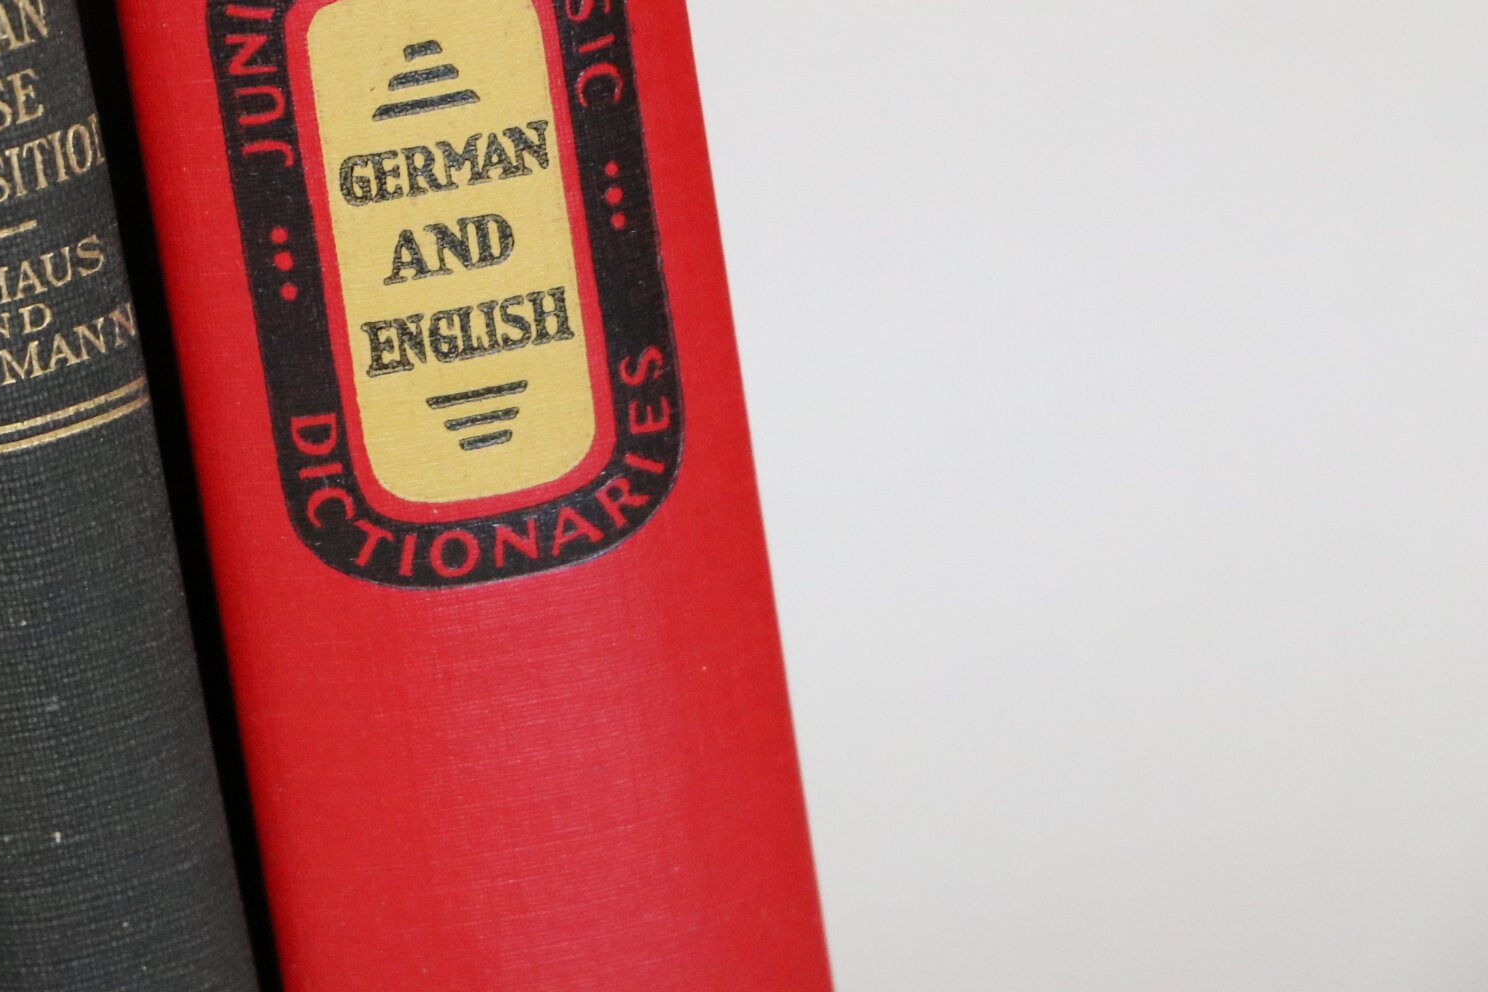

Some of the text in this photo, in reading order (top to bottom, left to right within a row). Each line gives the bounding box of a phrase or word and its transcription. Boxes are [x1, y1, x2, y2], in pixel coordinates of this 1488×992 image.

[339, 119, 550, 208] GERMAN
[383, 212, 516, 286] AND
[360, 285, 575, 378] ENGLISH
[290, 344, 671, 579] DICTIONARIES
